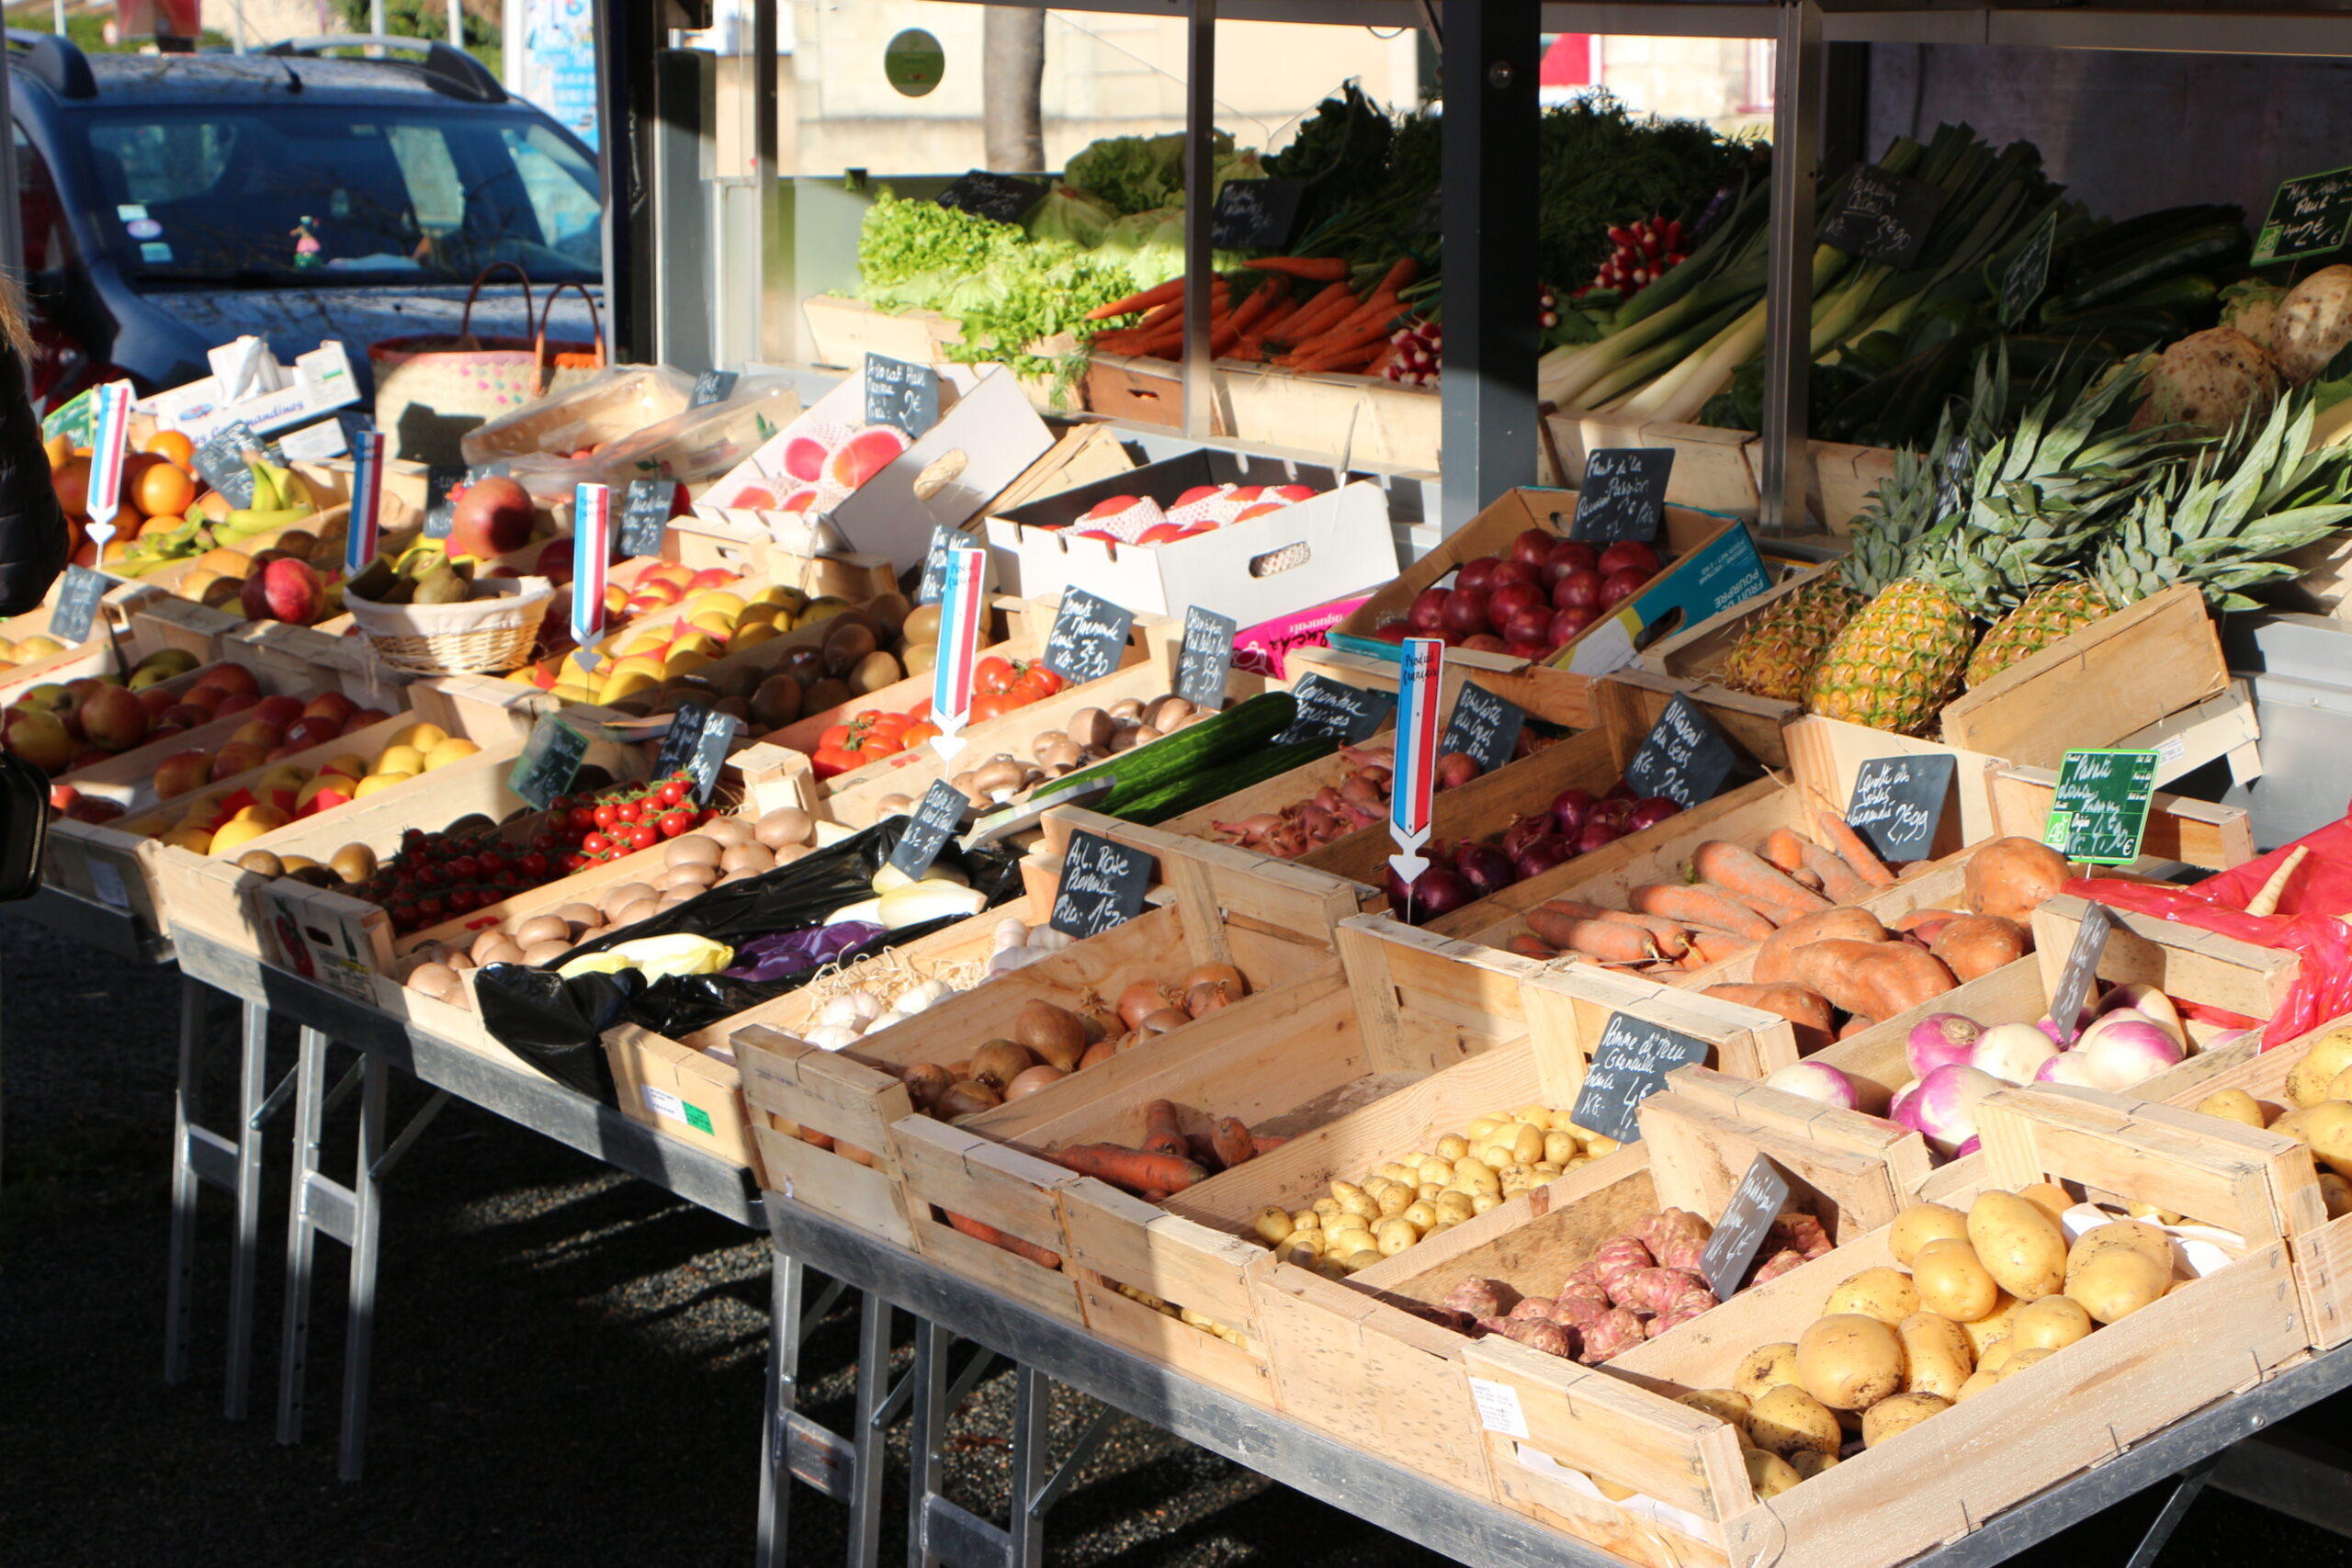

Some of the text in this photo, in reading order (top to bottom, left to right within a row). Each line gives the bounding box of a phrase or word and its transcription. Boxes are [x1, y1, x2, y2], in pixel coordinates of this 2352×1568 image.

[1713, 568, 1760, 610] POURPRE
[1736, 578, 1764, 604] FRUIT
[1406, 651, 1434, 667] Produit
[1652, 724, 1668, 750] du
[2047, 822, 2065, 842] AB
[2122, 838, 2135, 856] €
[1601, 1016, 1638, 1051] Pomme
